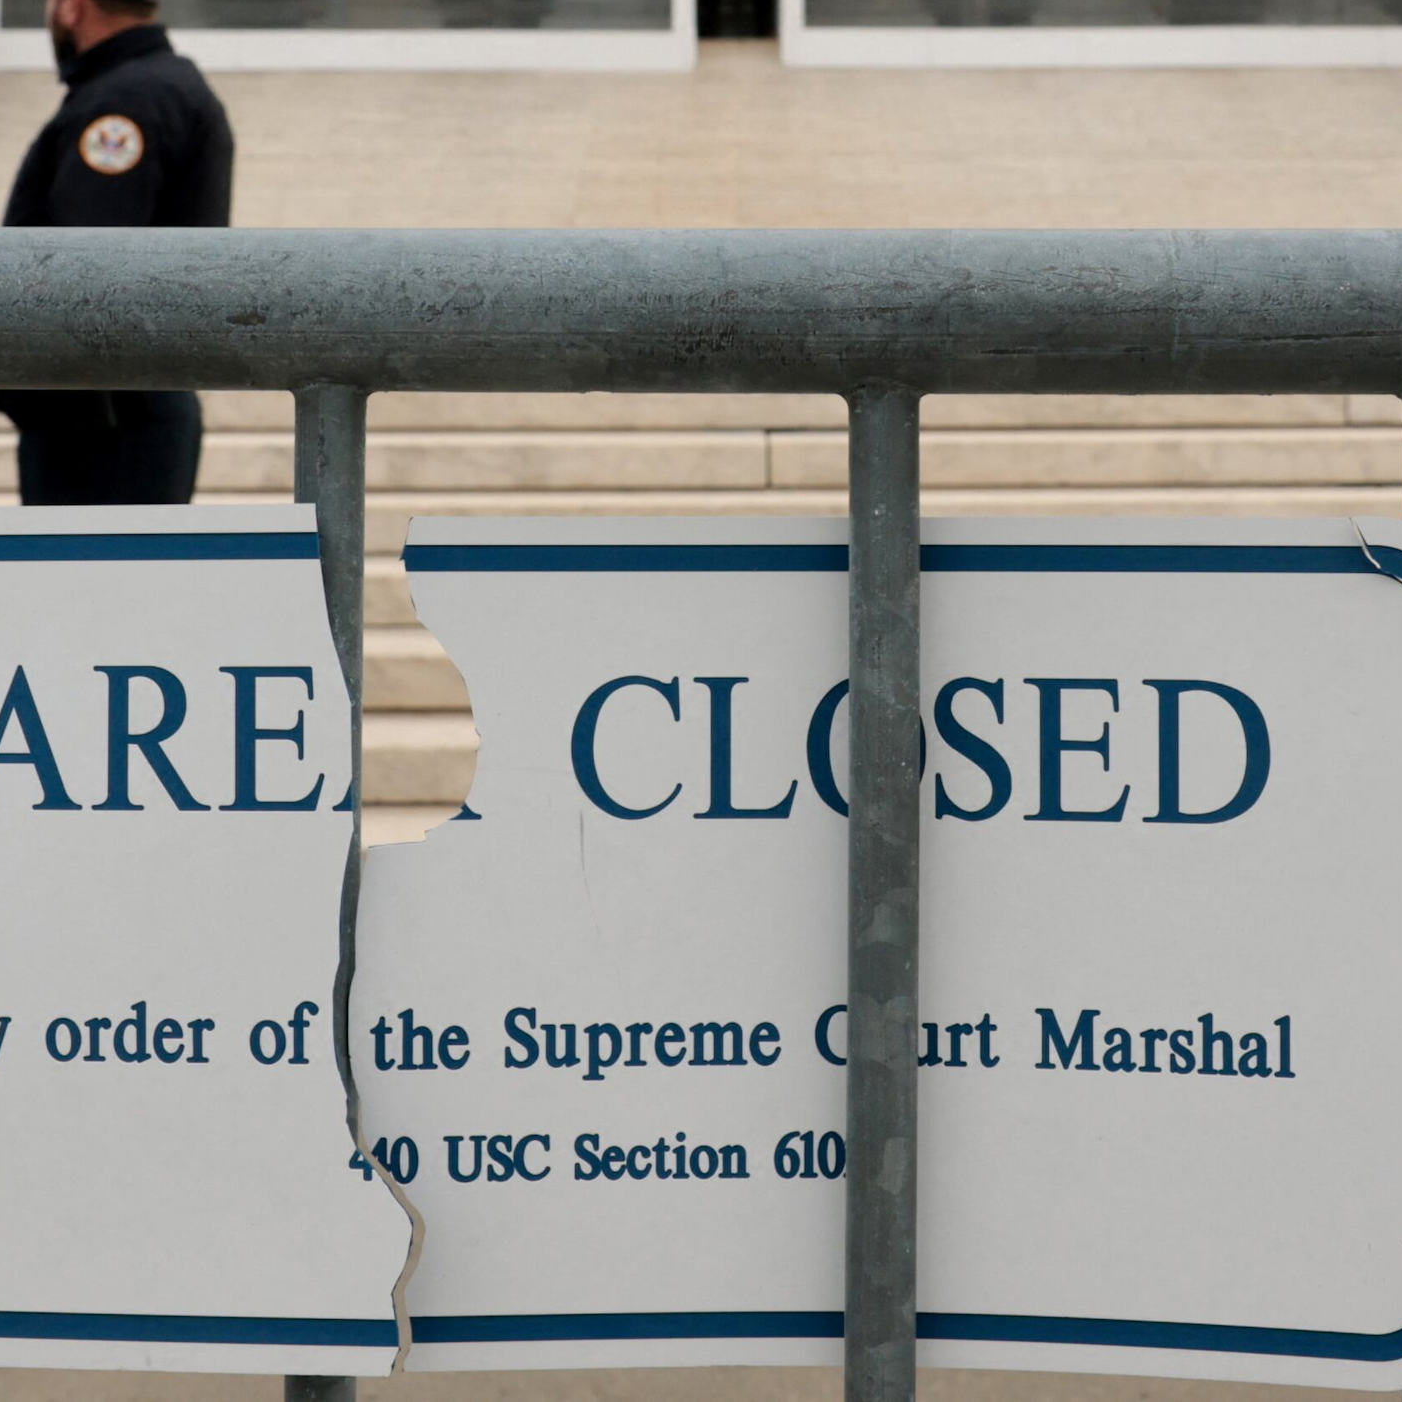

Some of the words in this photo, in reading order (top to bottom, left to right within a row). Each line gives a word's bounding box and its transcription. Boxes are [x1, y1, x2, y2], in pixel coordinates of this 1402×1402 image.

[45, 1001, 215, 1064] order
[250, 1001, 320, 1066] of
[369, 1009, 470, 1071] the
[504, 1007, 782, 1081] Supreme
[814, 1004, 1000, 1068] Curt
[1036, 1008, 1296, 1079] Marshal
[444, 1134, 552, 1184] USC
[574, 1131, 750, 1181] Section
[773, 1130, 847, 1180] 610
